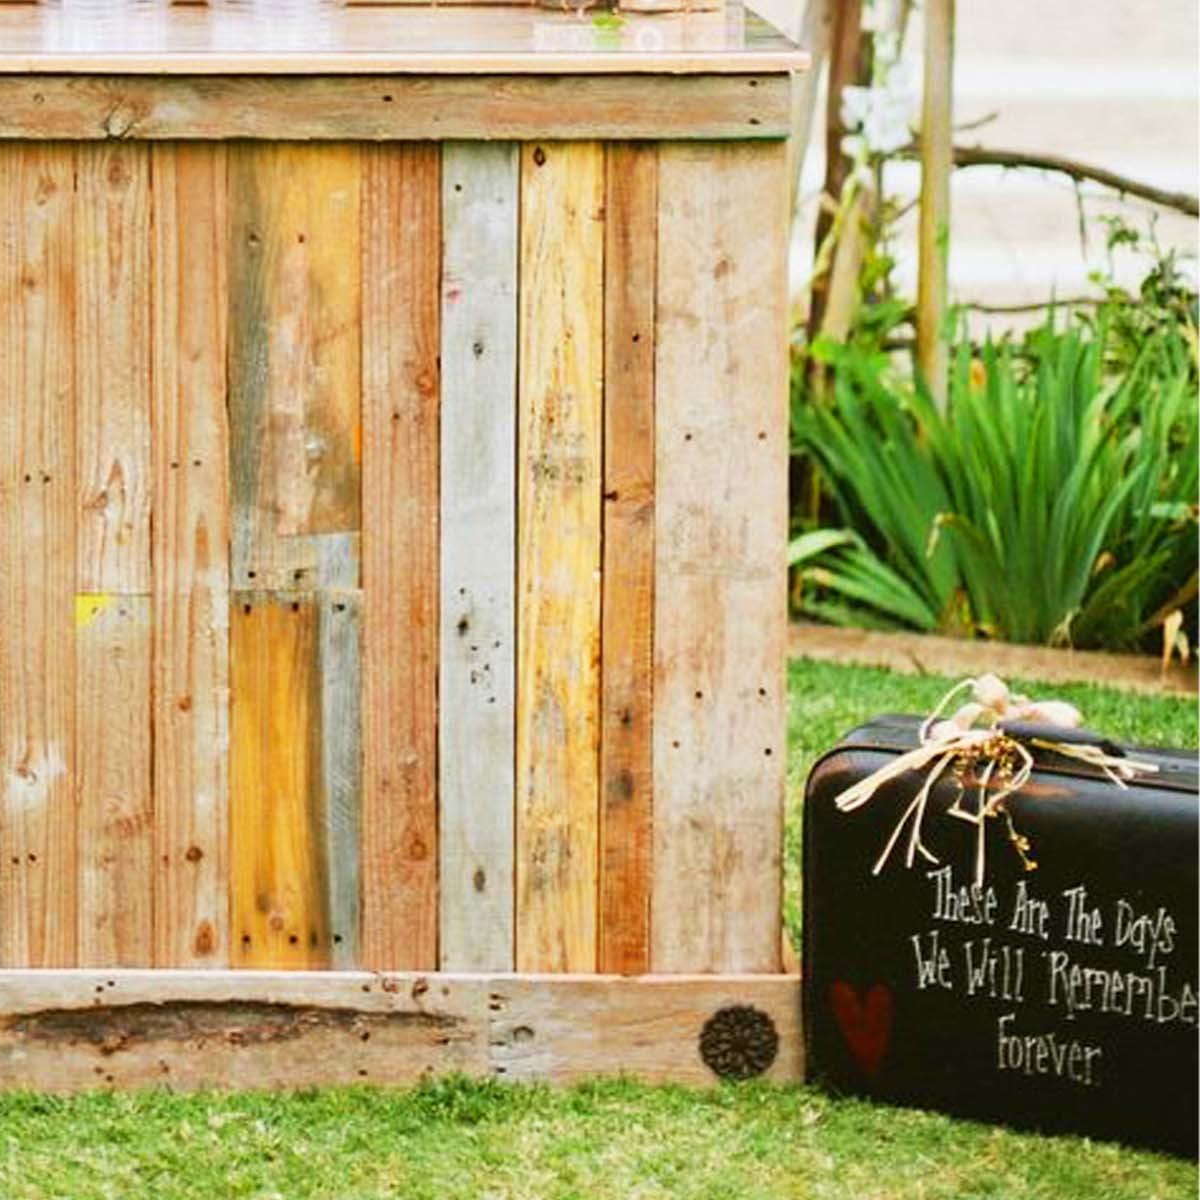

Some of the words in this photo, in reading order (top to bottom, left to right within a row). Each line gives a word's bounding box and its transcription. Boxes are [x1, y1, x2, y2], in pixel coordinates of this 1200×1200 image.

[927, 865, 998, 926] These
[1009, 880, 1050, 940] Are
[1062, 885, 1103, 945] The
[1115, 898, 1178, 970] Days
[911, 930, 953, 990] We
[964, 937, 1024, 1002] Will
[1048, 951, 1199, 1026] Remembe
[997, 1013, 1101, 1086] Forever
